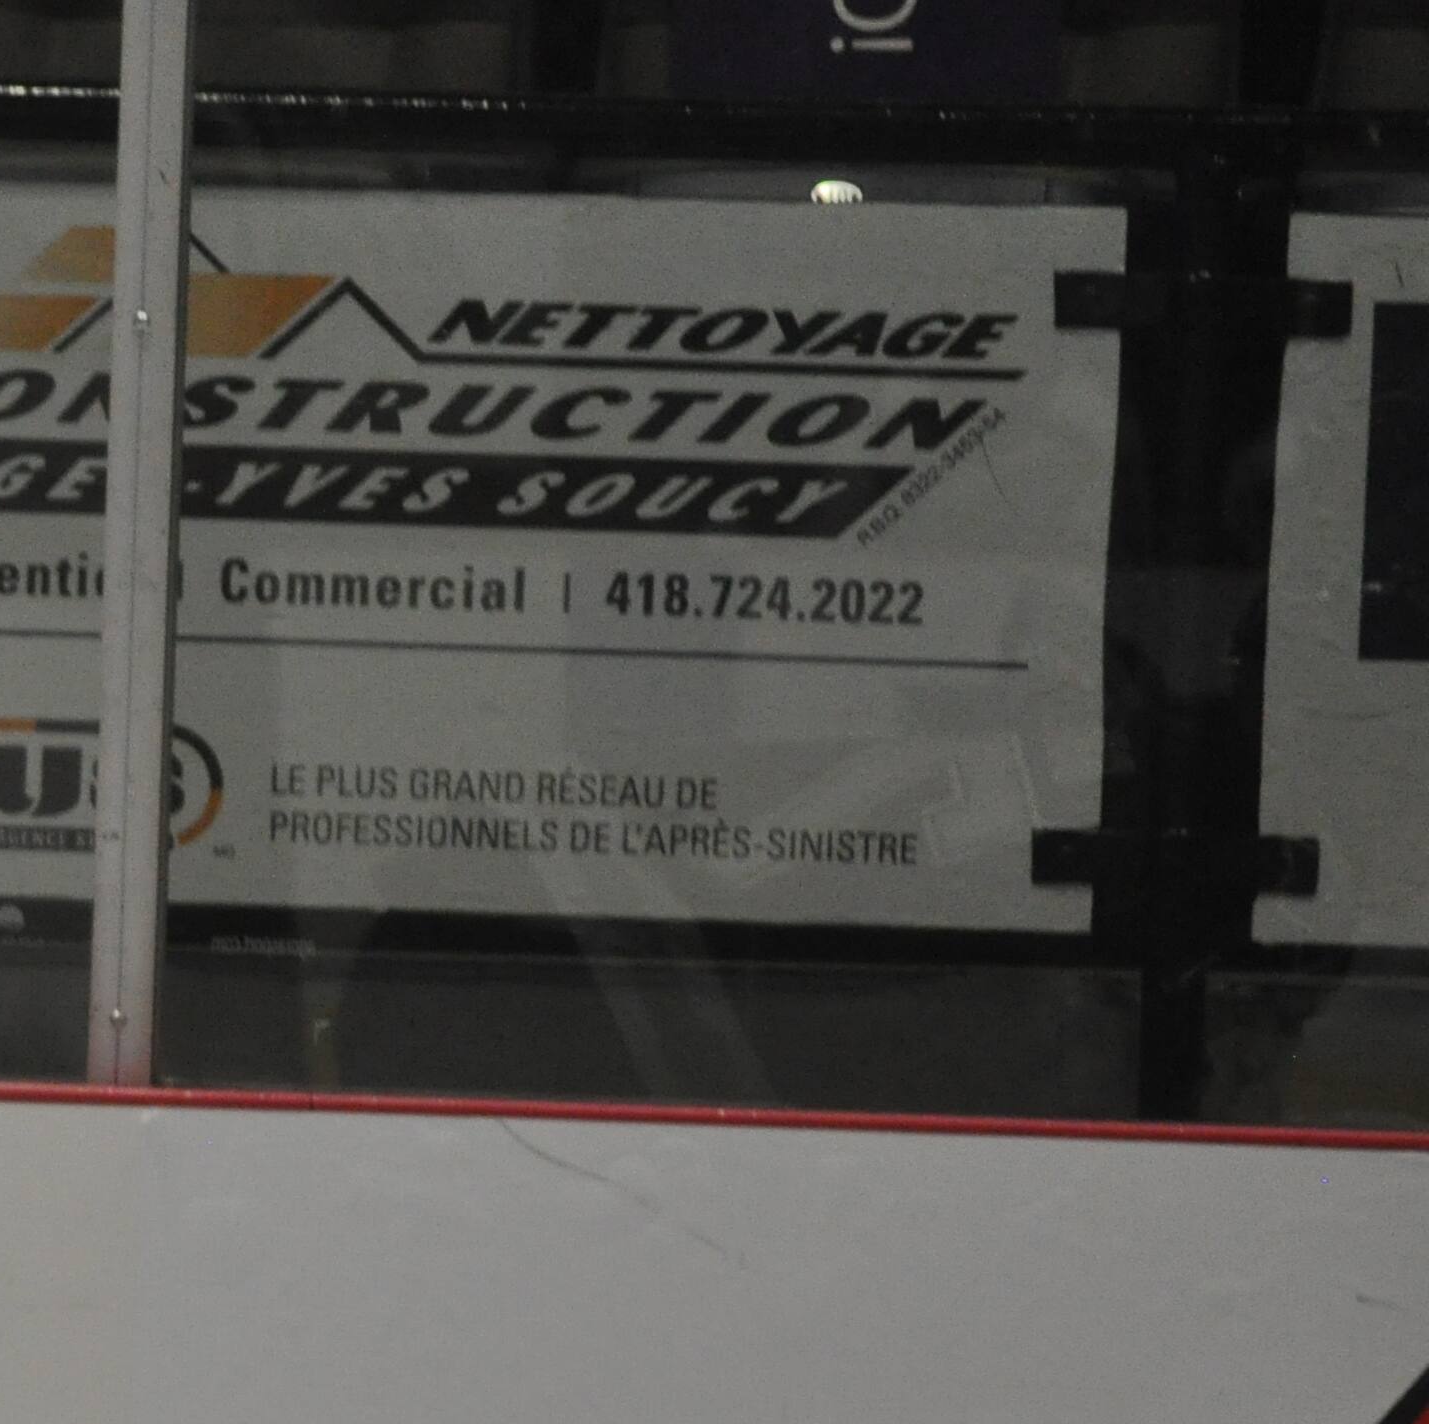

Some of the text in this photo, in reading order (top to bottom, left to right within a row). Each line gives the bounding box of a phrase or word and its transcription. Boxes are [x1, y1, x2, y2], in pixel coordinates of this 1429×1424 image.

[428, 298, 1018, 360] NETTOYAGE
[495, 468, 848, 526] SOUCY
[221, 554, 526, 612] Commercial
[605, 568, 924, 626] 418.724.2022
[269, 762, 718, 811] LE PLUS GRAND RÉSEAU DE
[268, 809, 559, 852] PROFESSIONNELS
[568, 820, 611, 855] DE
